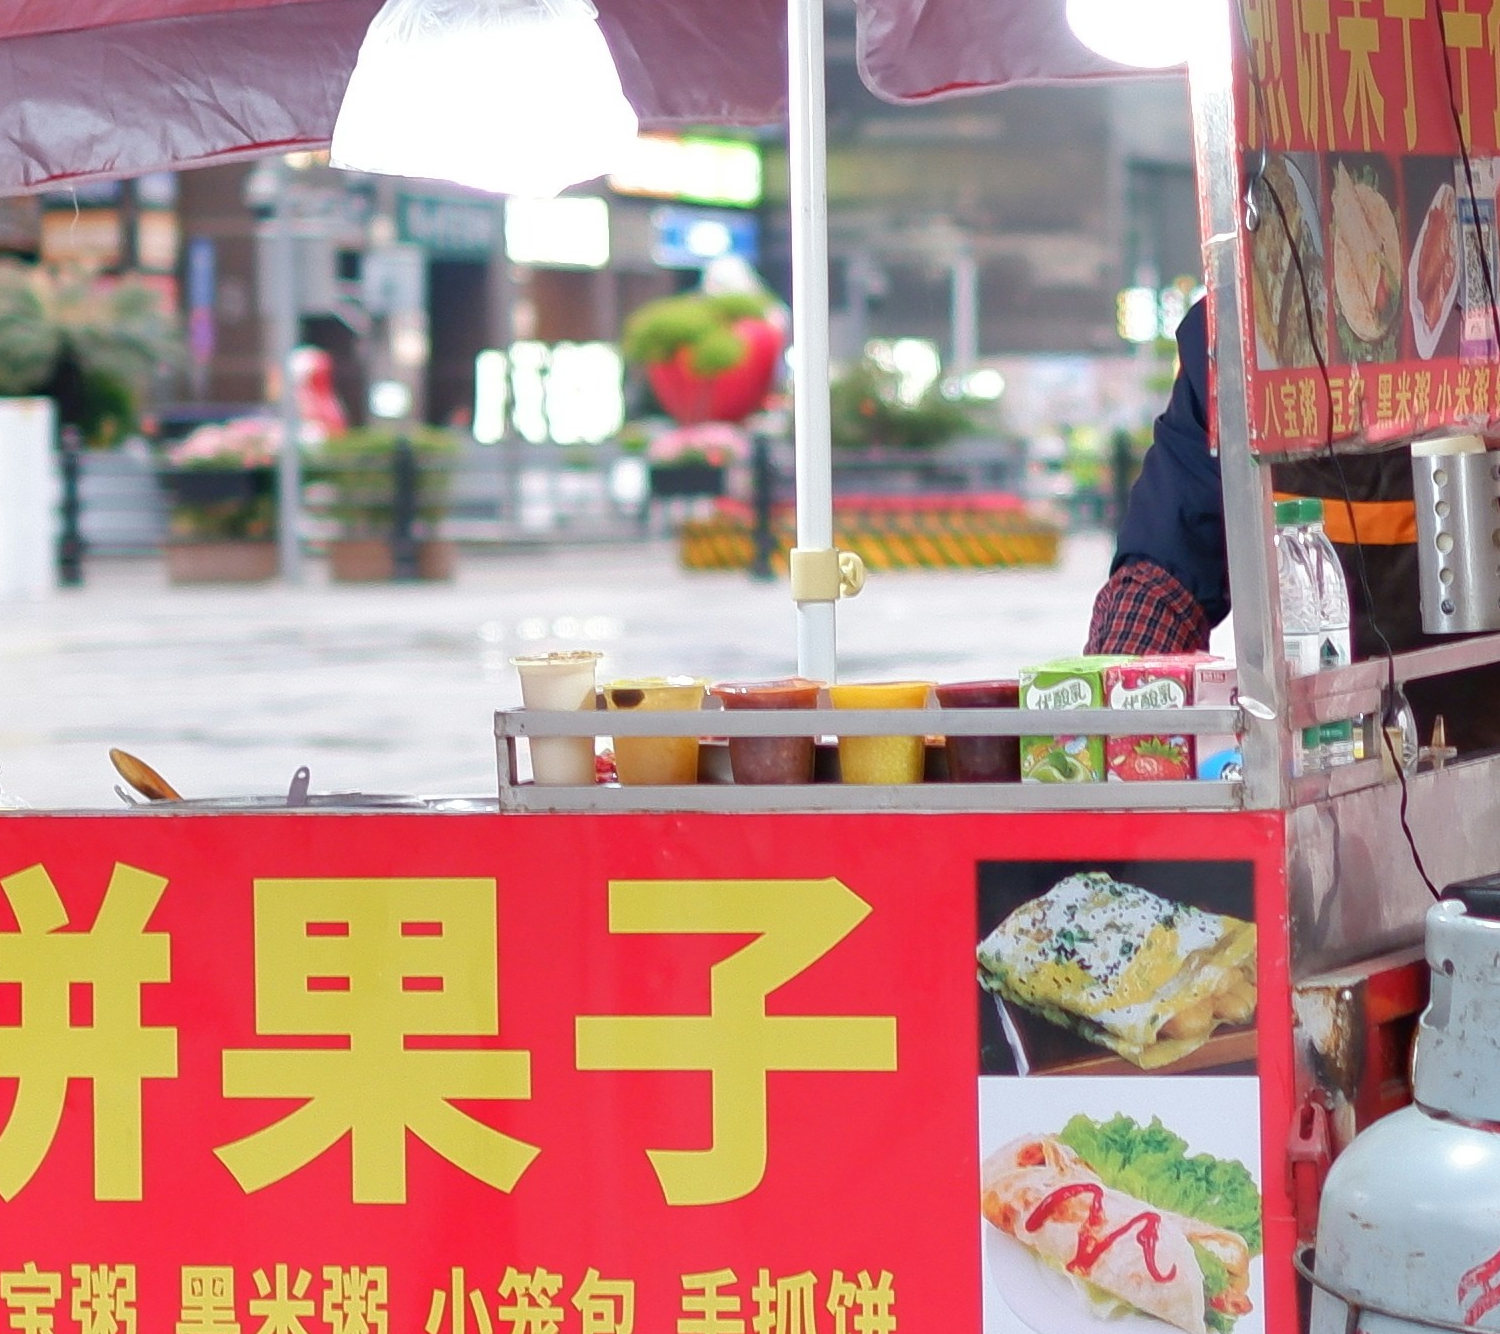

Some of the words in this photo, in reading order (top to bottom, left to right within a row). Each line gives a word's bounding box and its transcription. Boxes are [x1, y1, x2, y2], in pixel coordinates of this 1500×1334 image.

[1376, 370, 1430, 429] 黑米粥
[1435, 366, 1490, 425] 小米粥
